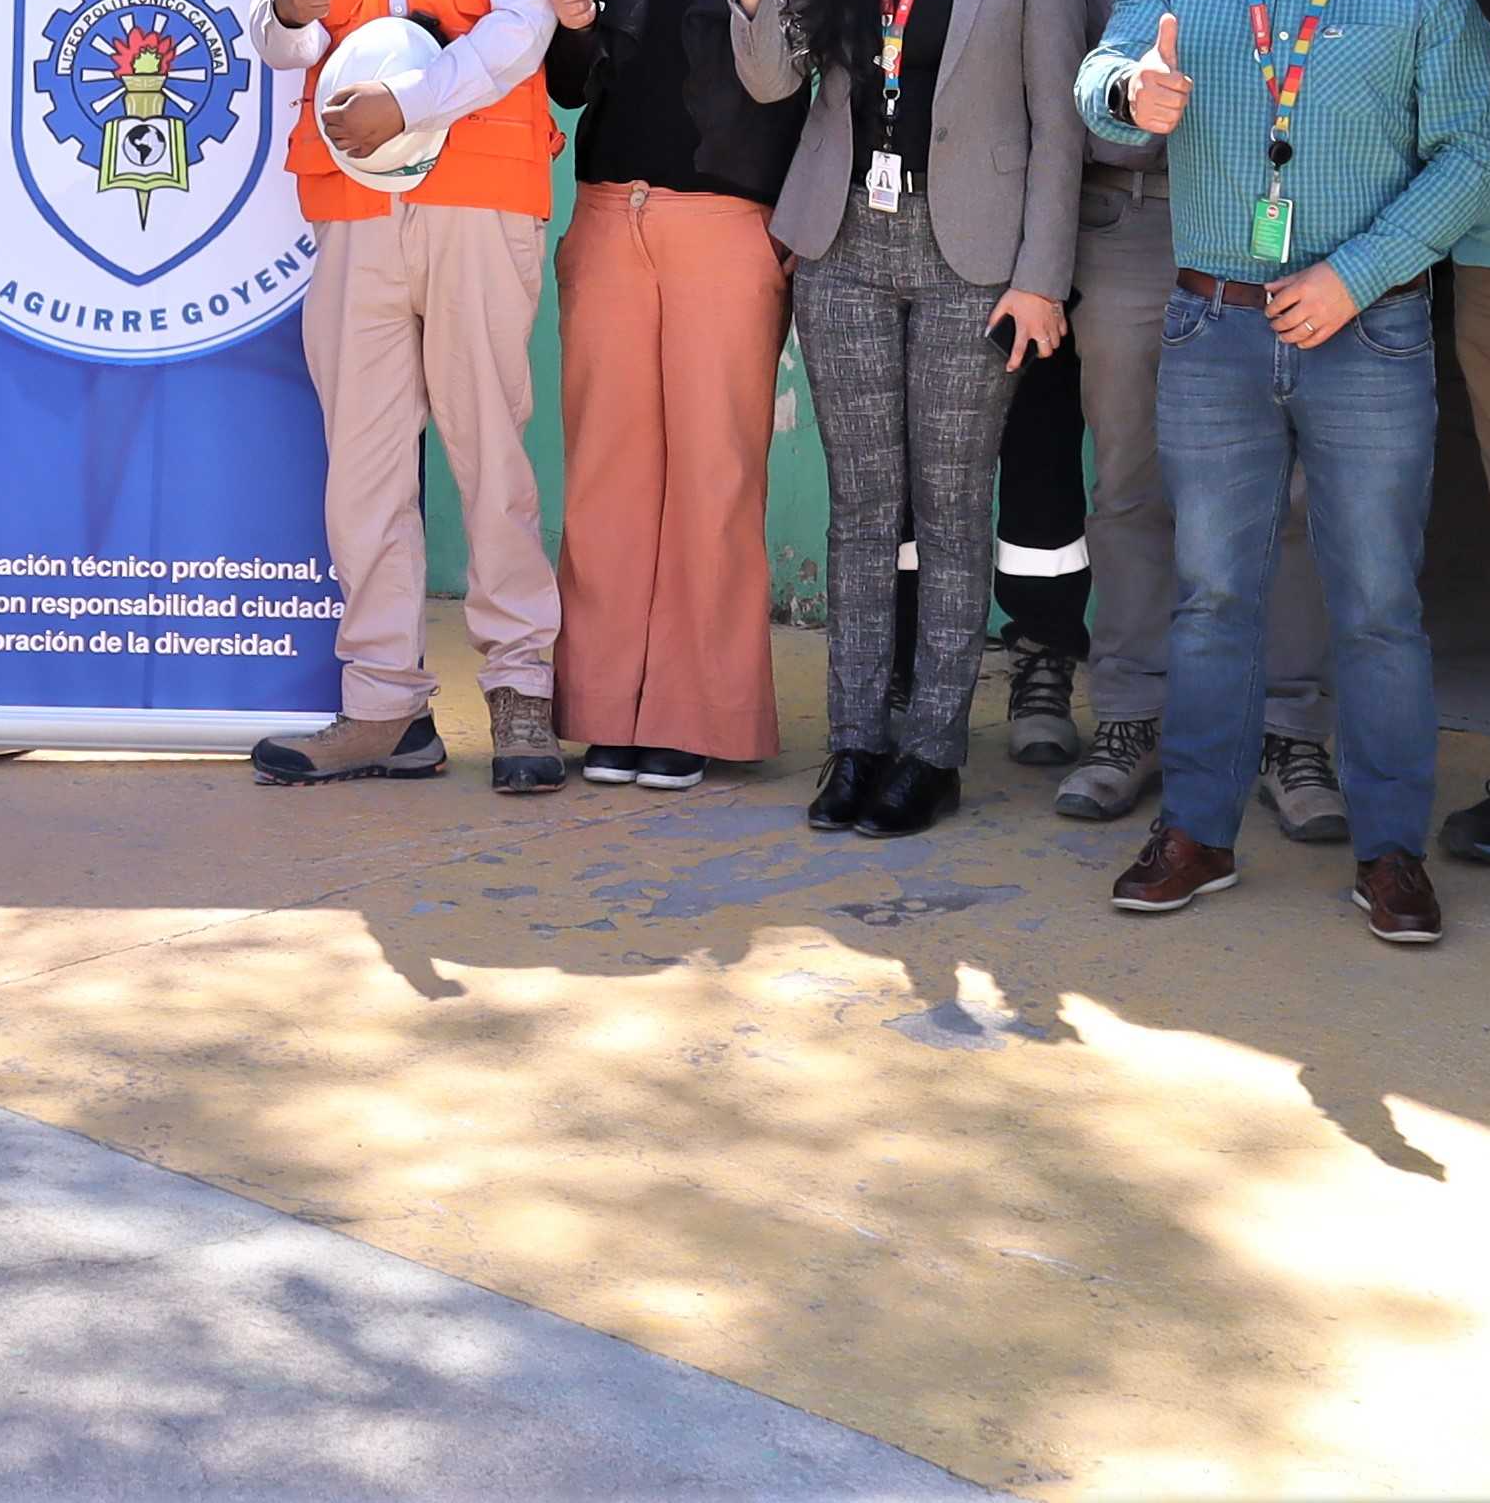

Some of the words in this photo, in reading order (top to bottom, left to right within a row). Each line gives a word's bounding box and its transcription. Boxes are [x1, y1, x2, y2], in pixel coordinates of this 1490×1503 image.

[61, 26, 85, 71] LICEO
[188, 10, 225, 69] CALAMA
[71, 555, 167, 579] técnico
[171, 556, 323, 584] profesional,
[31, 593, 237, 620] responsabilidad
[88, 630, 123, 654] de
[127, 631, 150, 654] la
[154, 631, 299, 656] diversidad.
